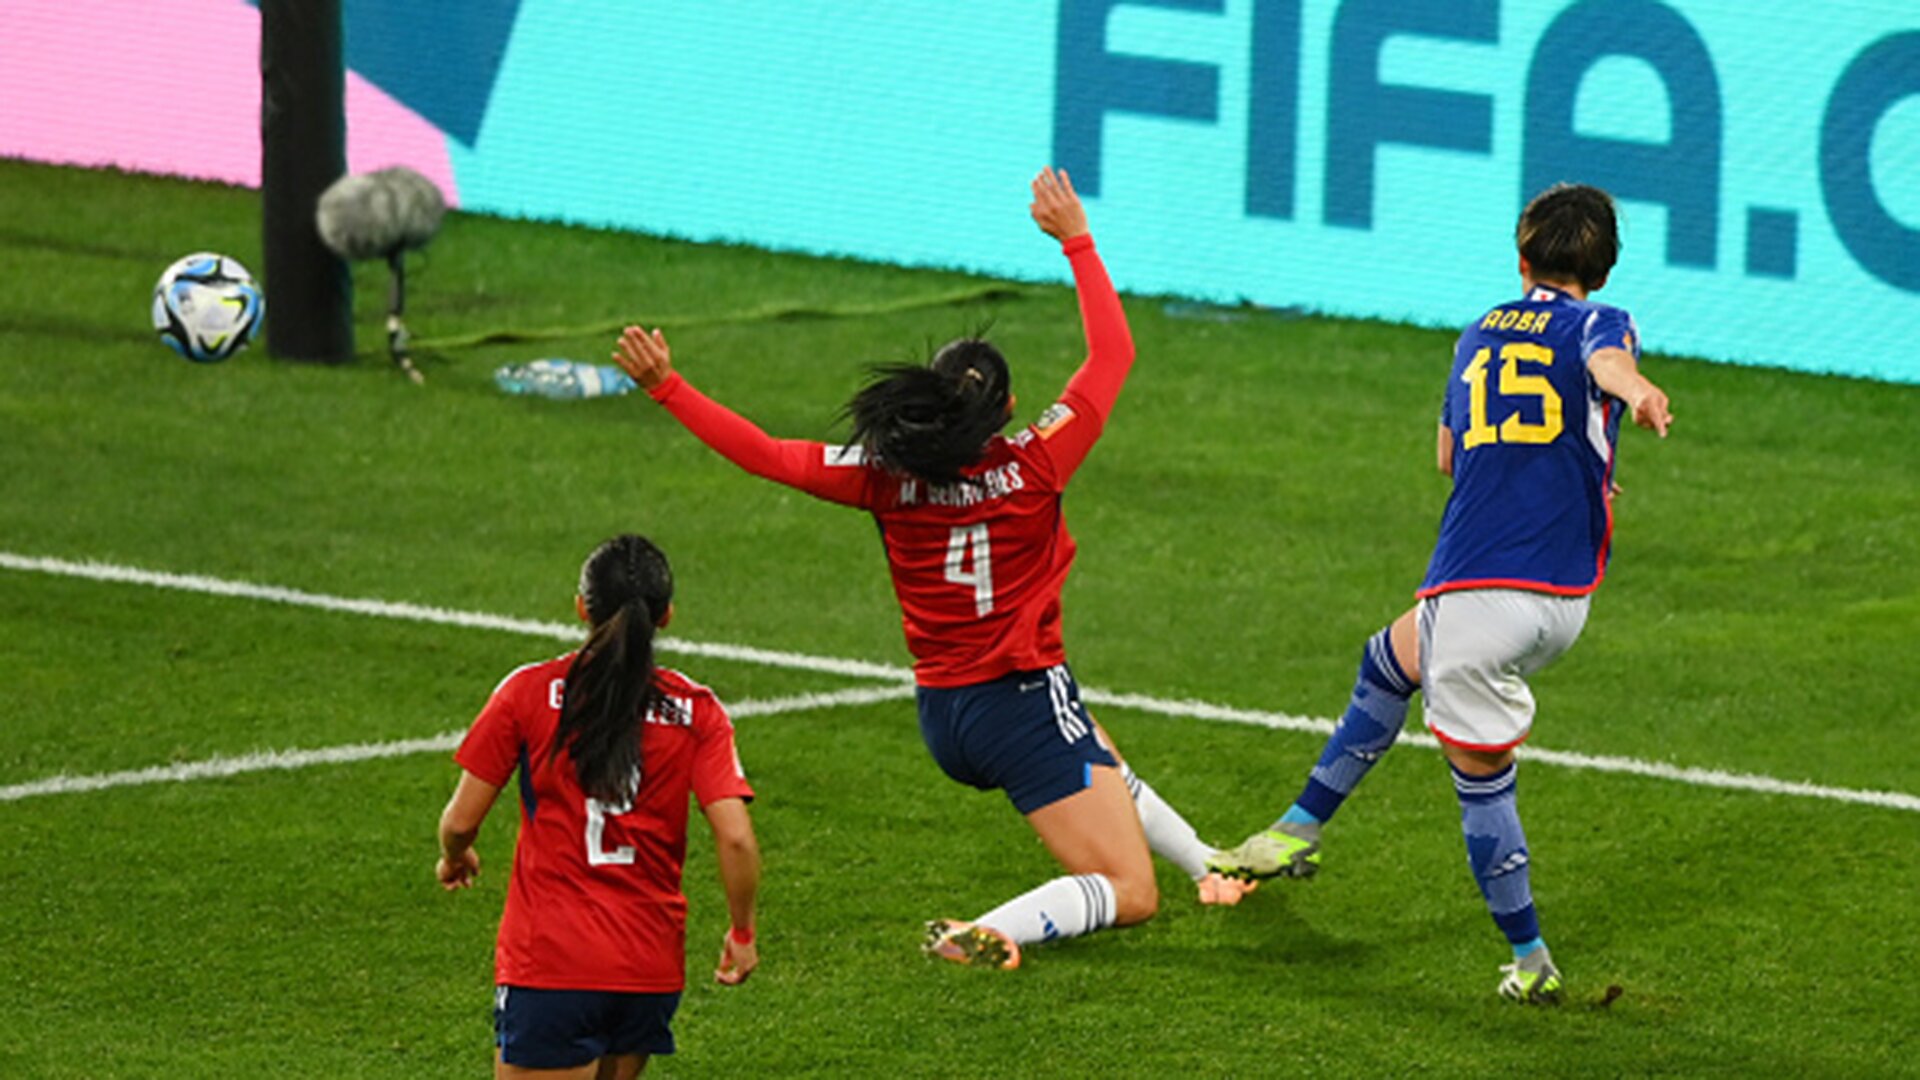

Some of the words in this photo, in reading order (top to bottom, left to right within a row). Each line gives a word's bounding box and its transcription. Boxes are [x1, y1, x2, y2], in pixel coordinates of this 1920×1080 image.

[1480, 309, 1552, 334] AOBA
[1461, 342, 1565, 450] 15
[927, 460, 1024, 508] BENAVDES
[944, 522, 994, 619] 4
